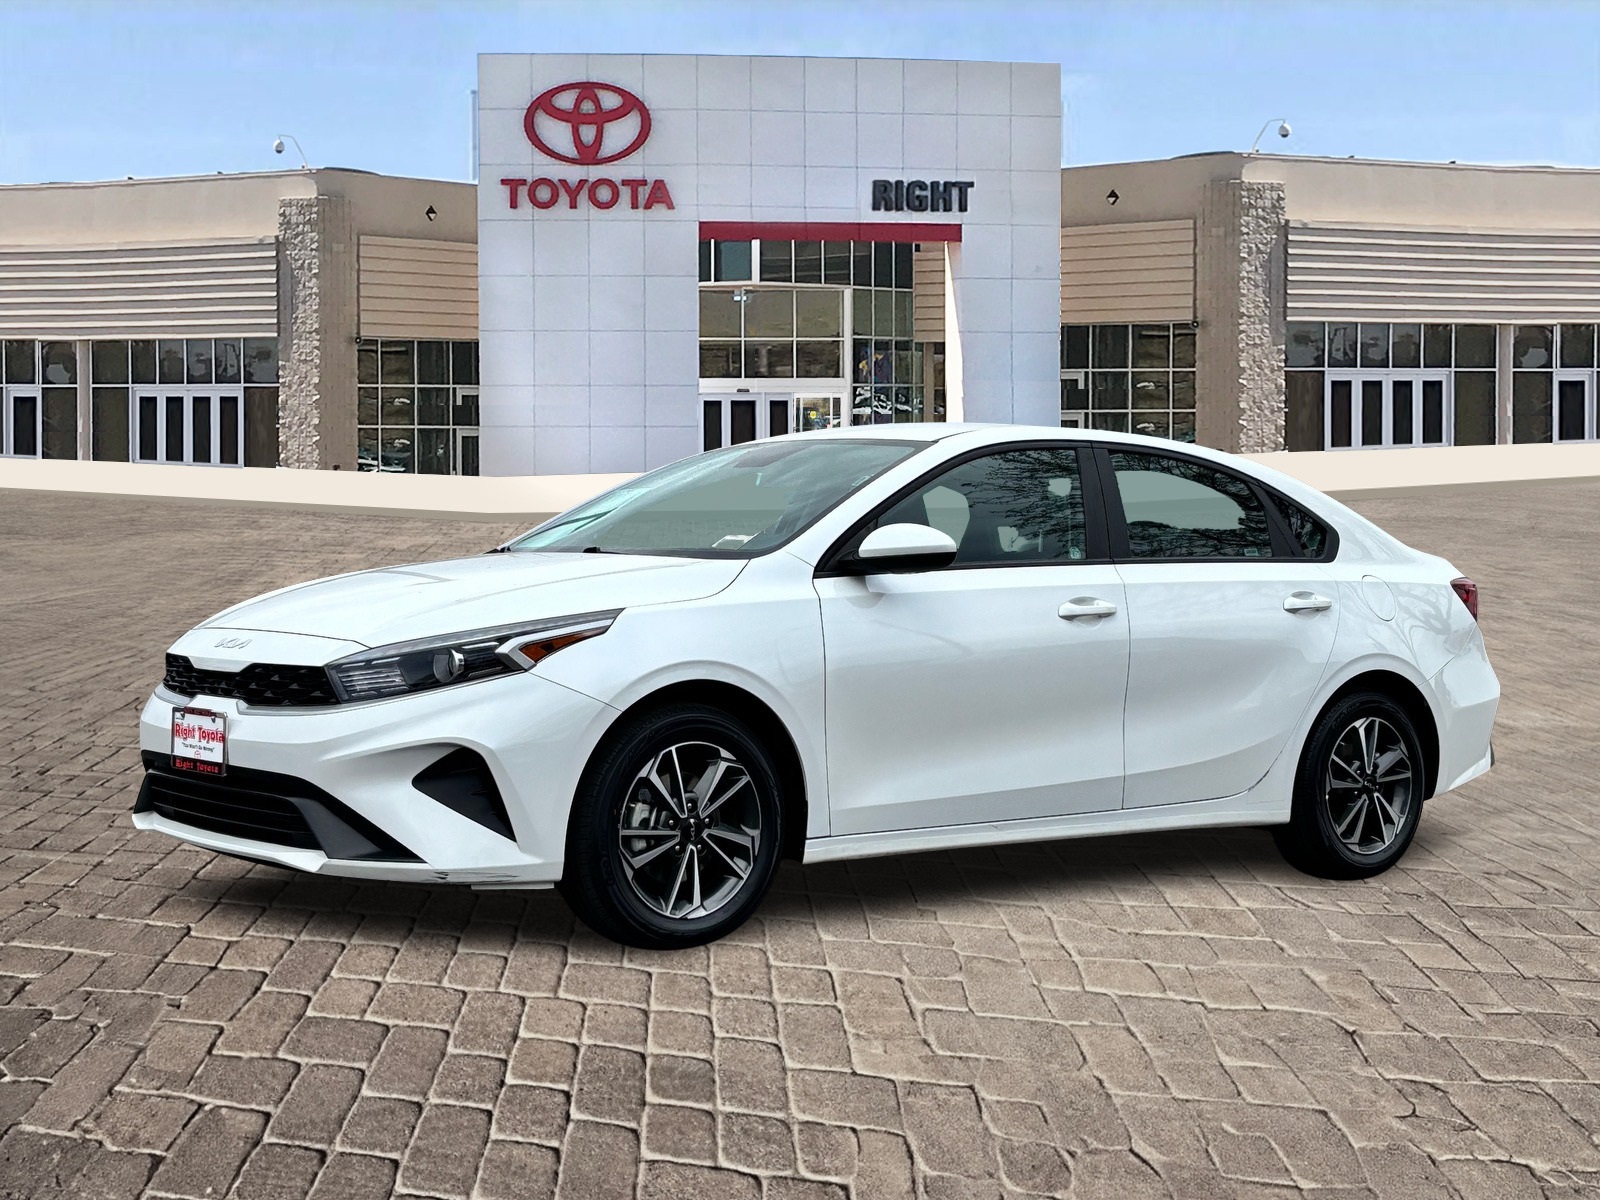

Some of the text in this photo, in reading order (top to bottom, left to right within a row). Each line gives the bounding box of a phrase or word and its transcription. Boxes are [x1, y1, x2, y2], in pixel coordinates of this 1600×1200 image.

[500, 178, 675, 210] TOYOTA
[871, 179, 975, 213] RIGHT
[175, 723, 225, 744] Right Toyota
